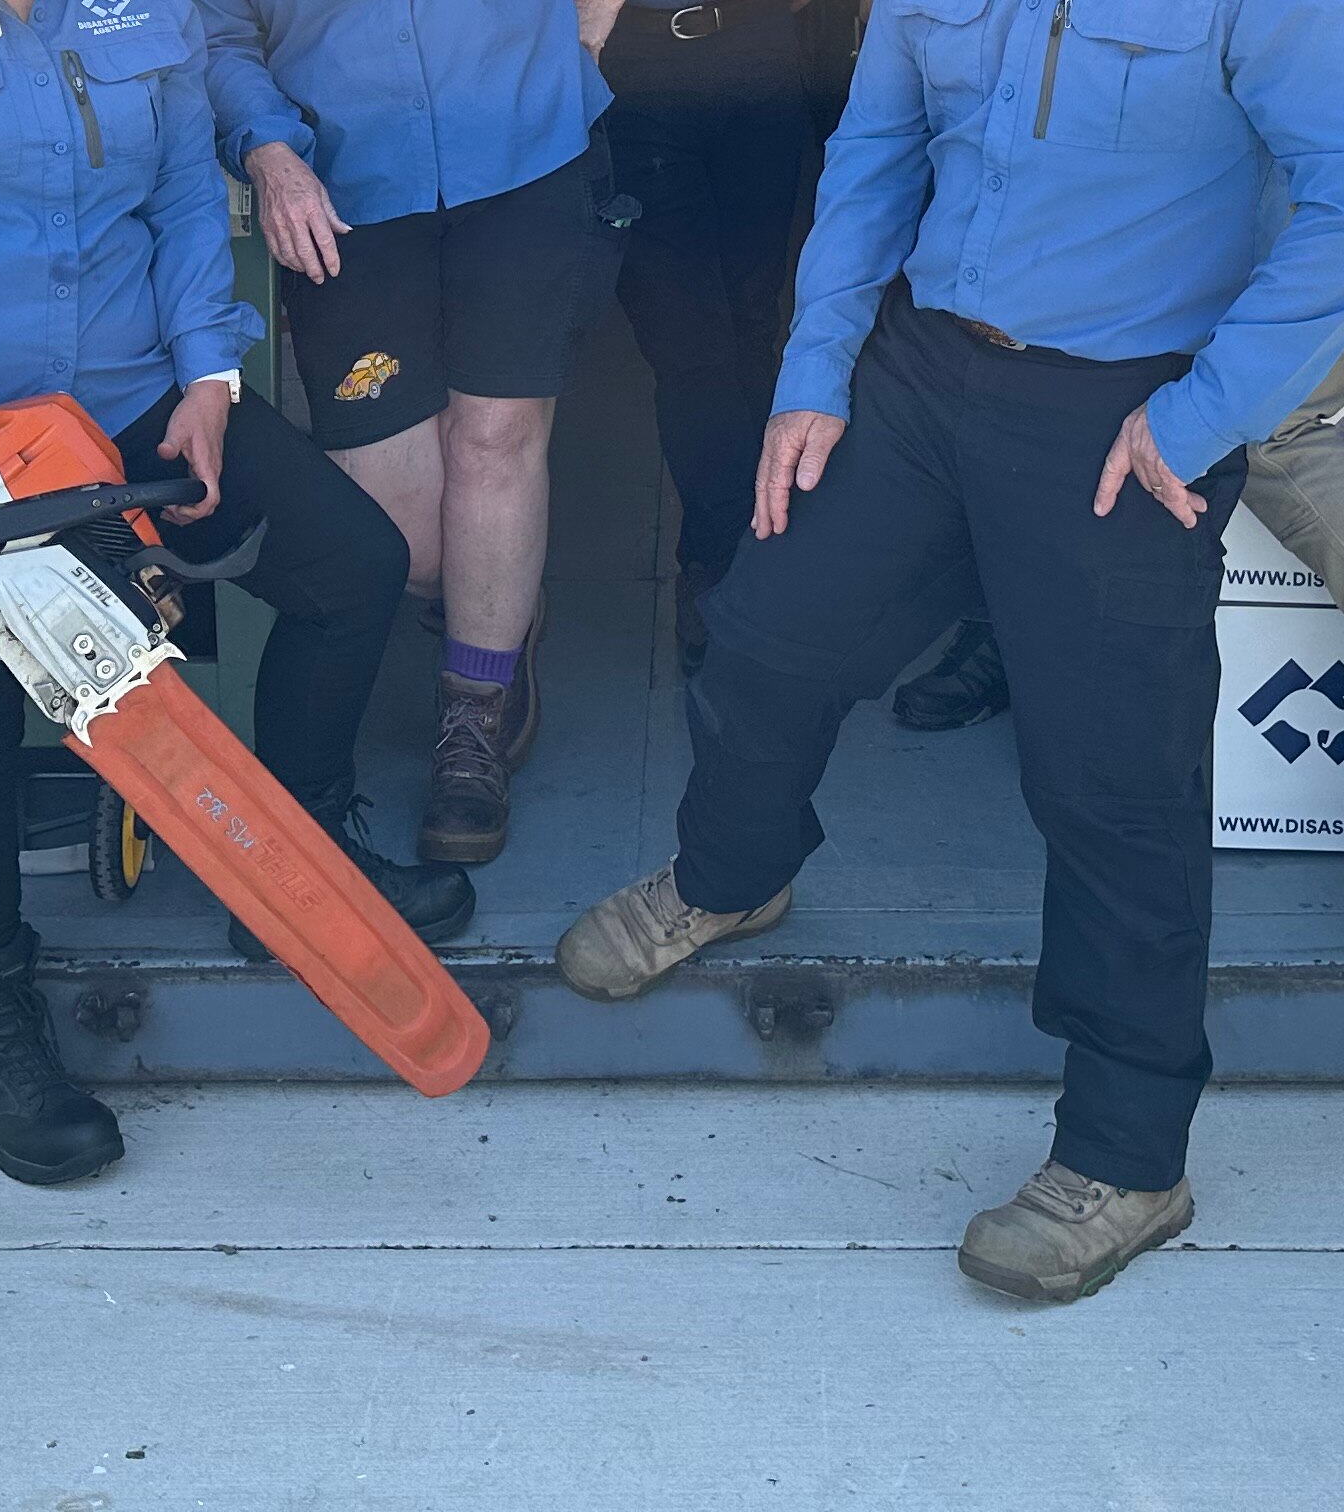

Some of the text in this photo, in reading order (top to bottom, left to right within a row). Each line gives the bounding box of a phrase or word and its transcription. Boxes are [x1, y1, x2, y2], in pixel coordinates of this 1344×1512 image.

[77, 12, 150, 31] DISASTER RELIEF
[92, 21, 142, 36] AUSTRALIA
[70, 565, 116, 608] STIHL
